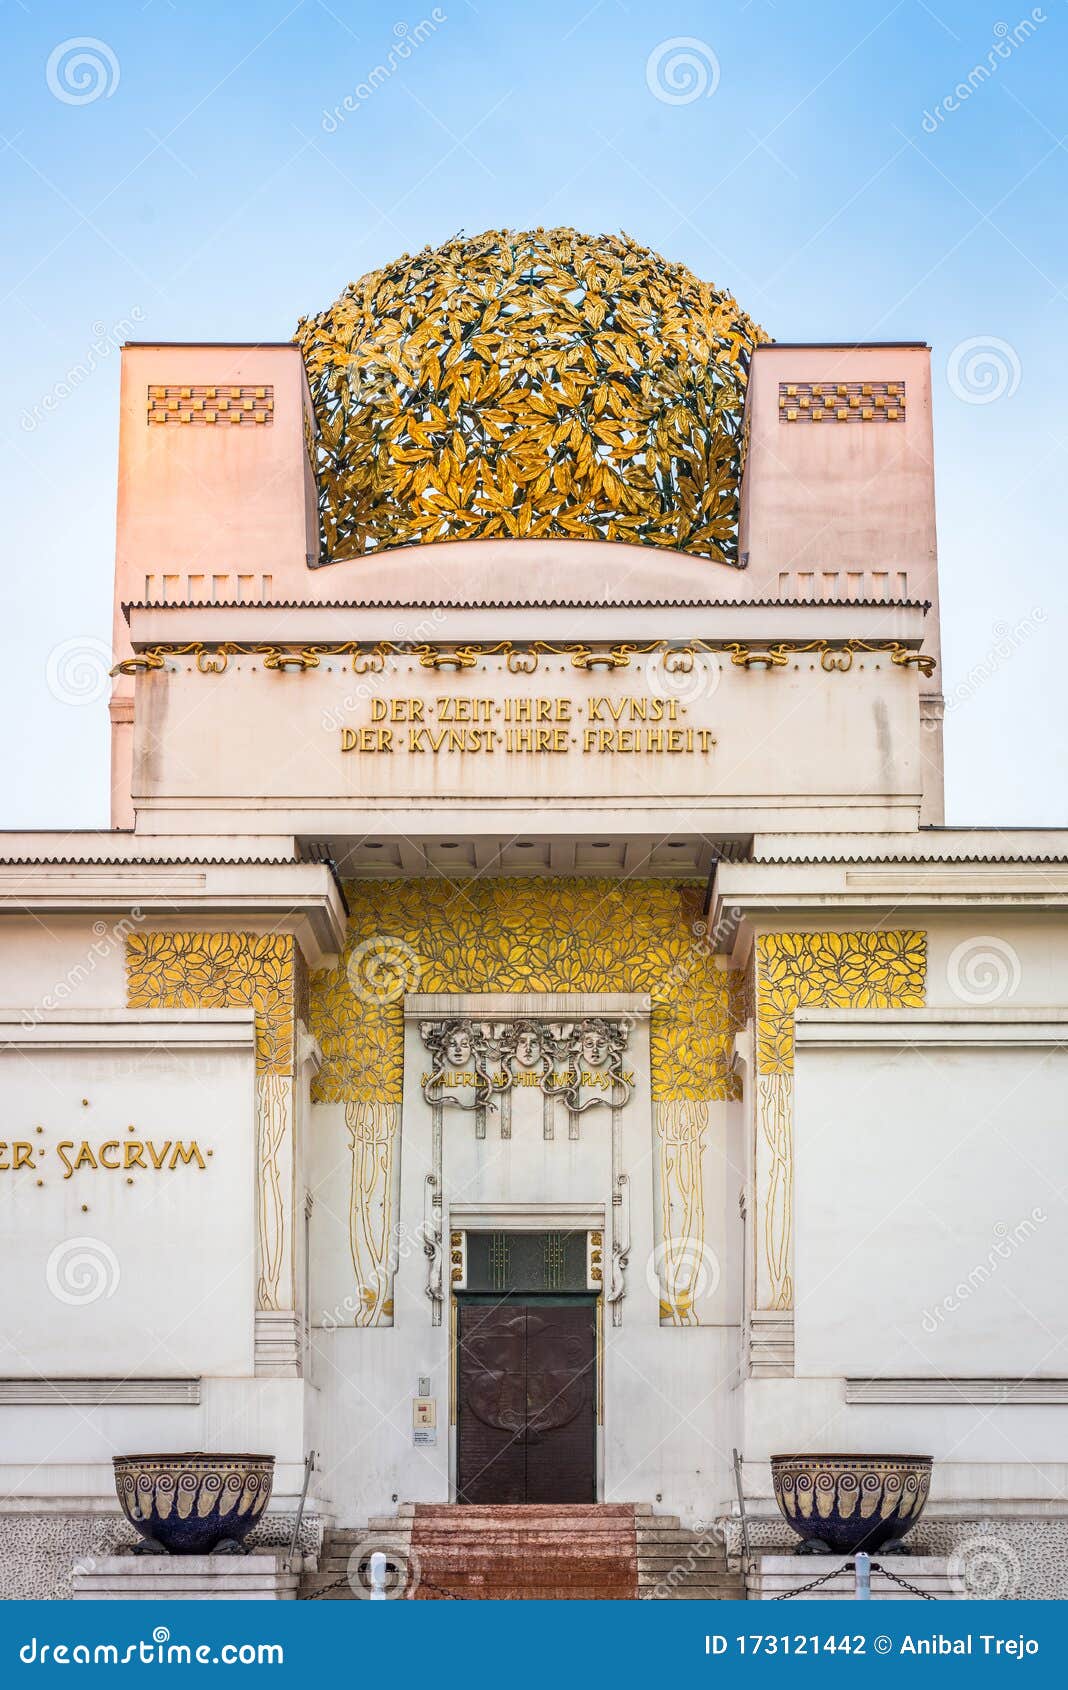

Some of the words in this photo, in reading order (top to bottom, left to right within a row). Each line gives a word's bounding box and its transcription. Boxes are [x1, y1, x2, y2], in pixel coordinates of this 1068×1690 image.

[371, 698, 425, 722] DER
[437, 698, 495, 722] ZEIT
[504, 698, 572, 722] IHRE
[341, 728, 393, 752] DER
[506, 728, 569, 752] IHRE
[584, 728, 712, 752] FREIHEIT
[56, 1141, 206, 1179] SACRVM
